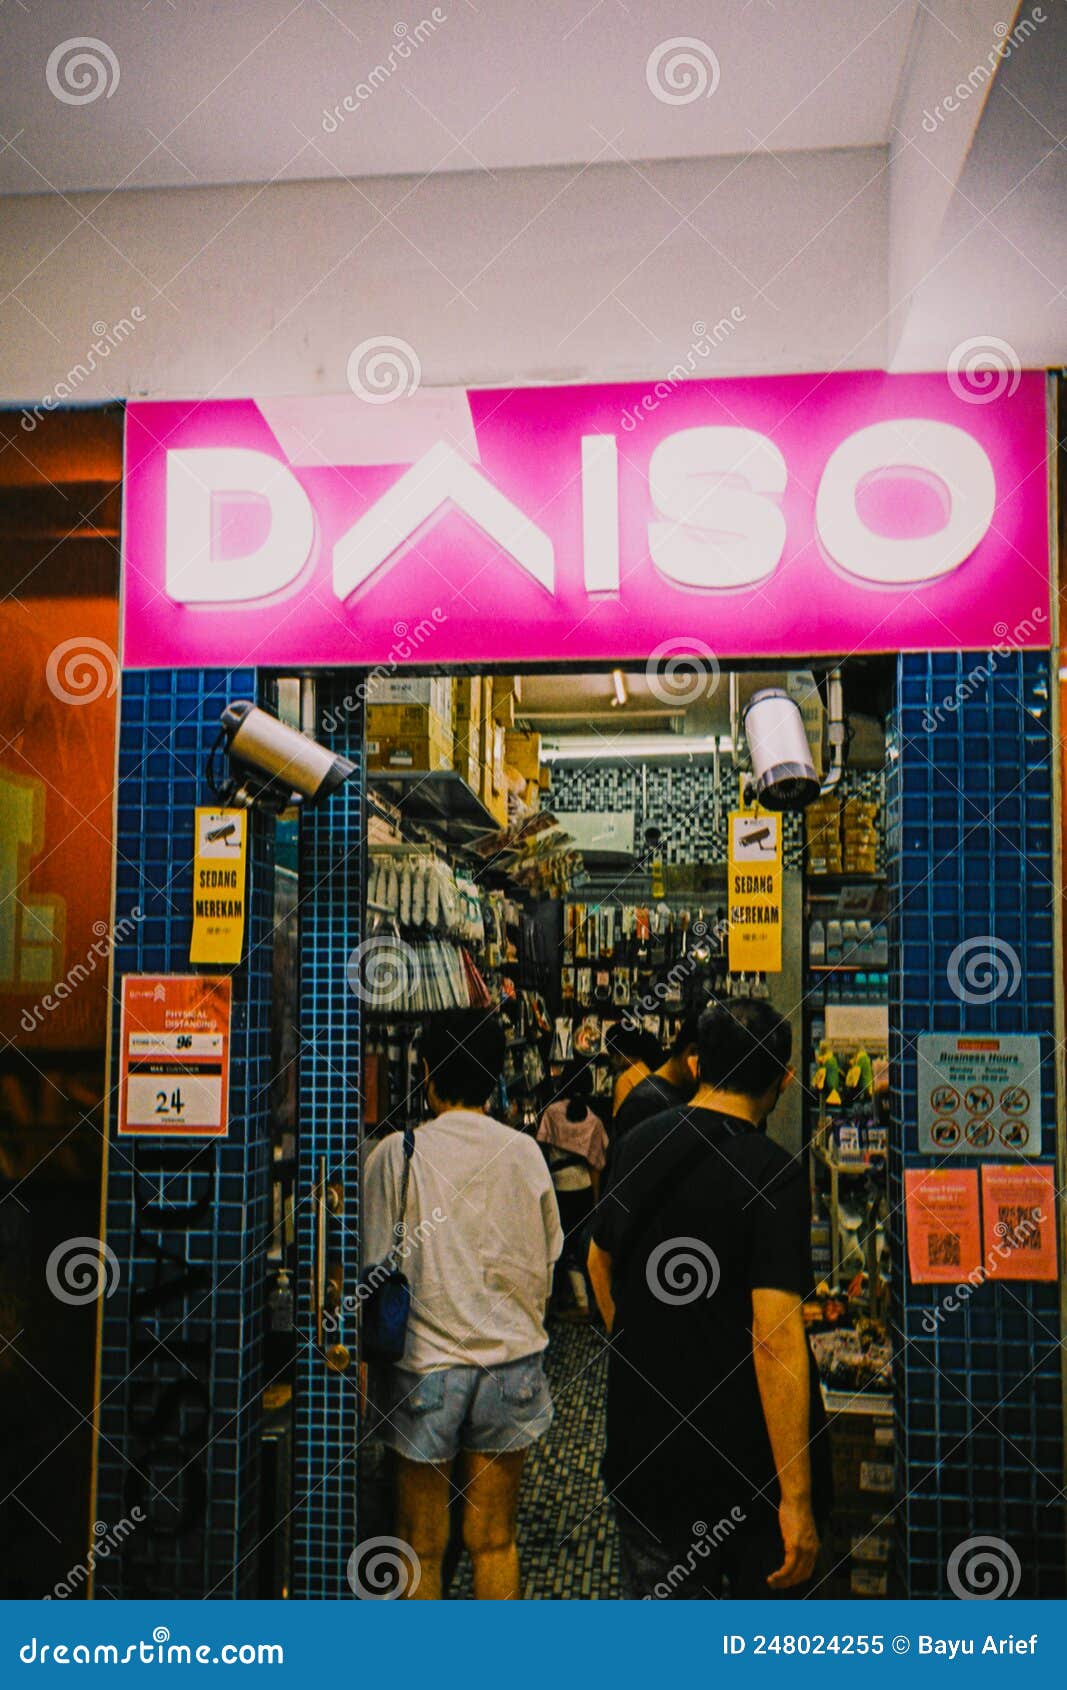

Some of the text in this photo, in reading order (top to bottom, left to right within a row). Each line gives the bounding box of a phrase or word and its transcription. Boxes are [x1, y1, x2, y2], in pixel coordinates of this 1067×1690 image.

[166, 418, 997, 606] DAISO
[199, 869, 237, 889] SEDANG
[734, 875, 774, 894] SEDANG
[195, 900, 242, 918] MEREKAM
[176, 1035, 193, 1050] 96
[155, 1087, 185, 1115] 24
[129, 1148, 214, 1538] DAISO
